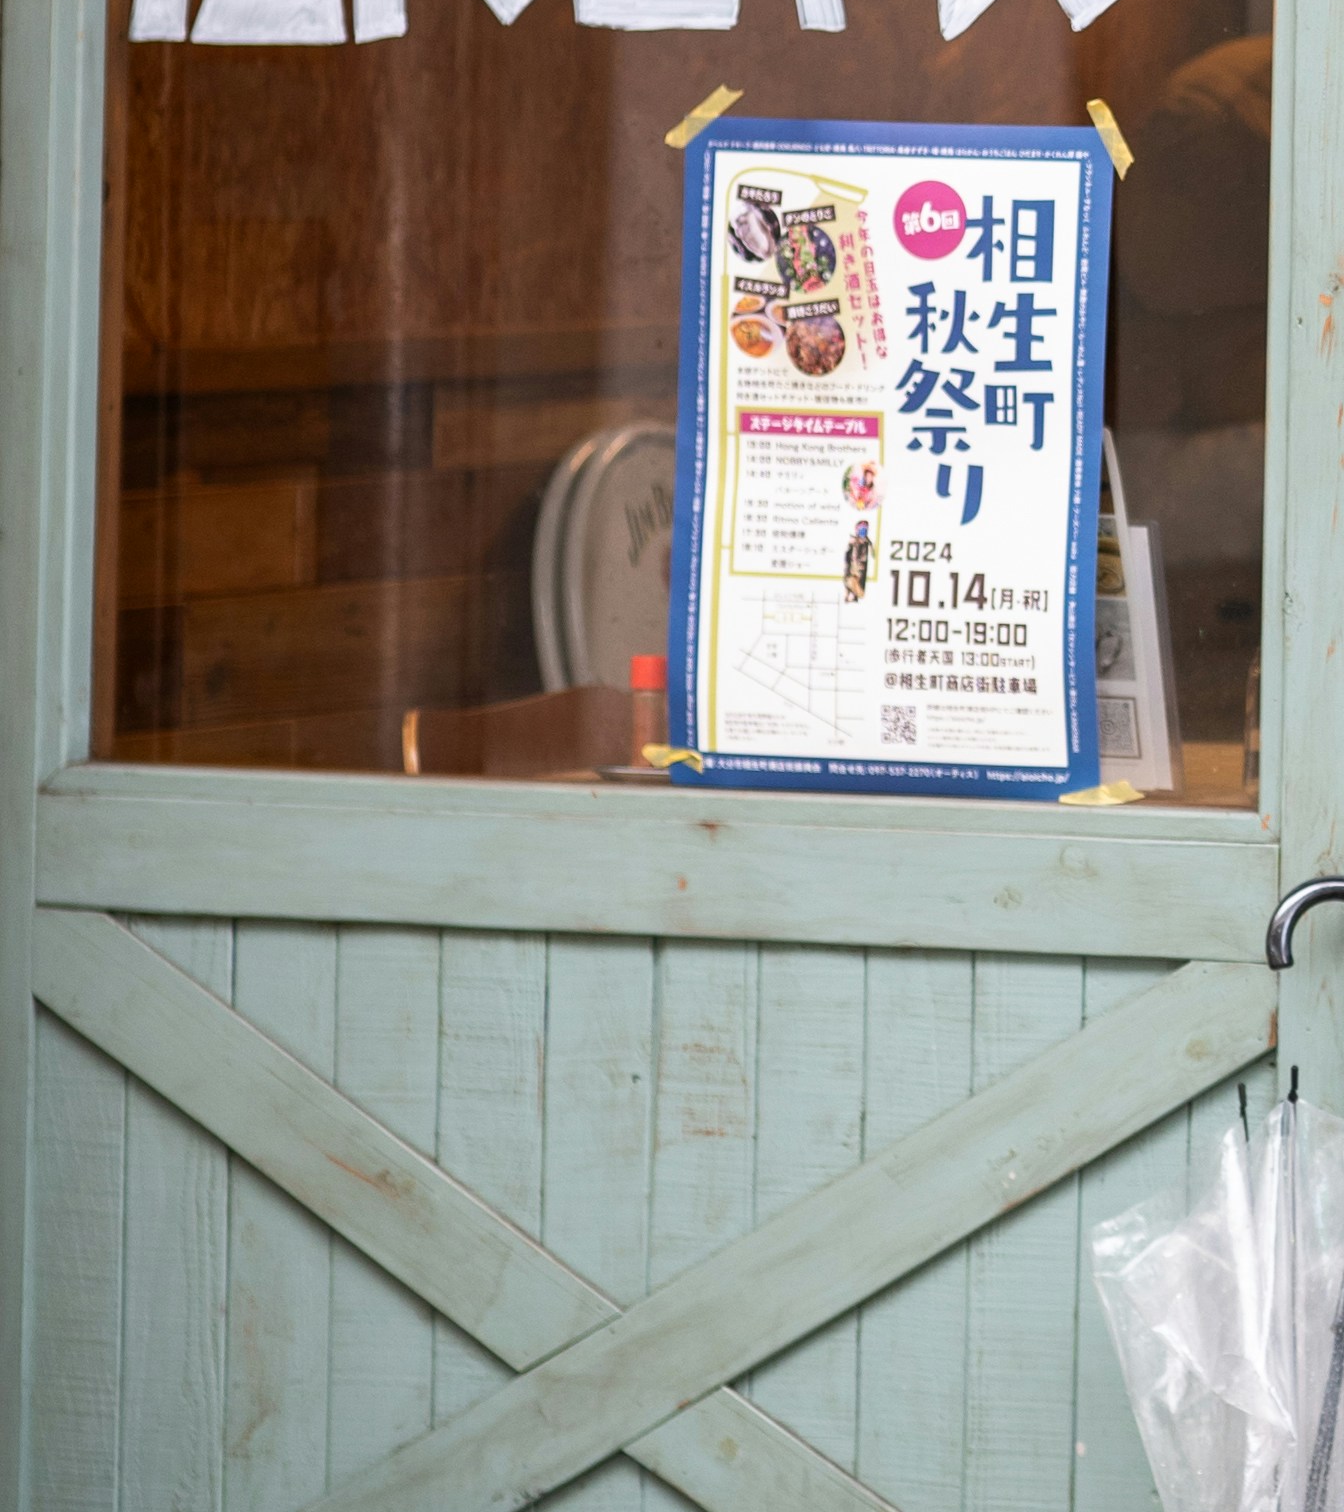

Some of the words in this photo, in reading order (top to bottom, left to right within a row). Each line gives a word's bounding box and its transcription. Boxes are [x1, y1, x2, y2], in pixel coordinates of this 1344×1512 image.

[902, 201, 960, 235] 第6回
[965, 195, 1058, 452] 相生町
[895, 280, 982, 526] 秋祭り
[890, 540, 953, 562] 2024
[886, 617, 1028, 647] 12:00-19:00
